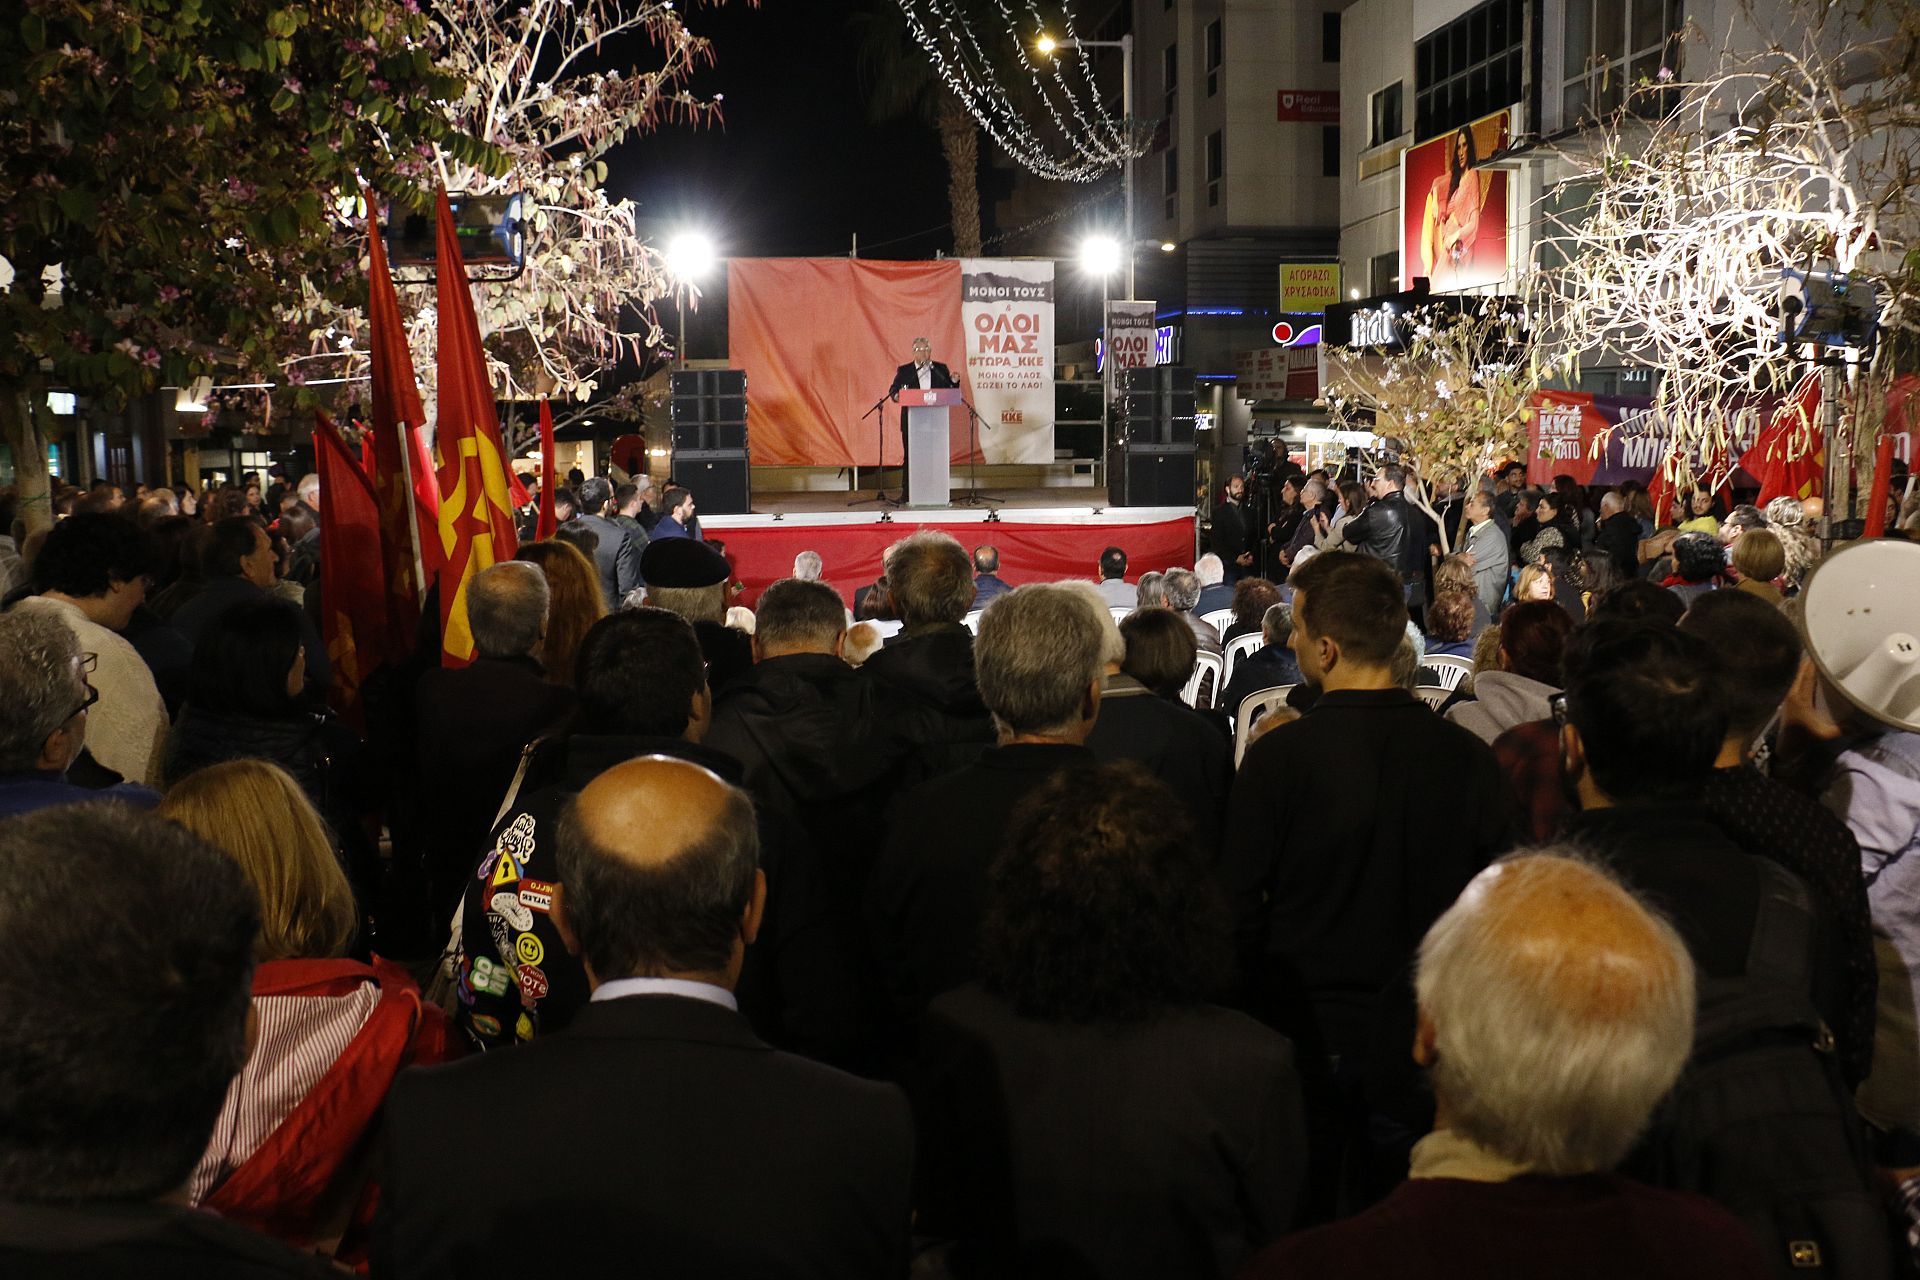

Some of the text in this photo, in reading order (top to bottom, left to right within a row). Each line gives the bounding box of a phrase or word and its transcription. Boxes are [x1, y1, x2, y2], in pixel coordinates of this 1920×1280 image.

[1290, 269, 1330, 281] ΑΓΟΡΑΖΩ
[969, 286, 1045, 297] ΜΟΝΟΙ ΤΟΥΣ
[1284, 286, 1336, 297] ΧΡΥΣΑΦΙΚΑ
[975, 313, 1040, 333] ΟΛΟΙ
[979, 335, 1038, 354] ΜΑΣ
[1113, 336, 1148, 352] ΟΛΟΙ
[968, 356, 1044, 368] #ΤΩΡΑ_ΚΚΕ
[1001, 412, 1023, 422] ΚΚΕ
[1539, 414, 1582, 435] ΚΚΕ
